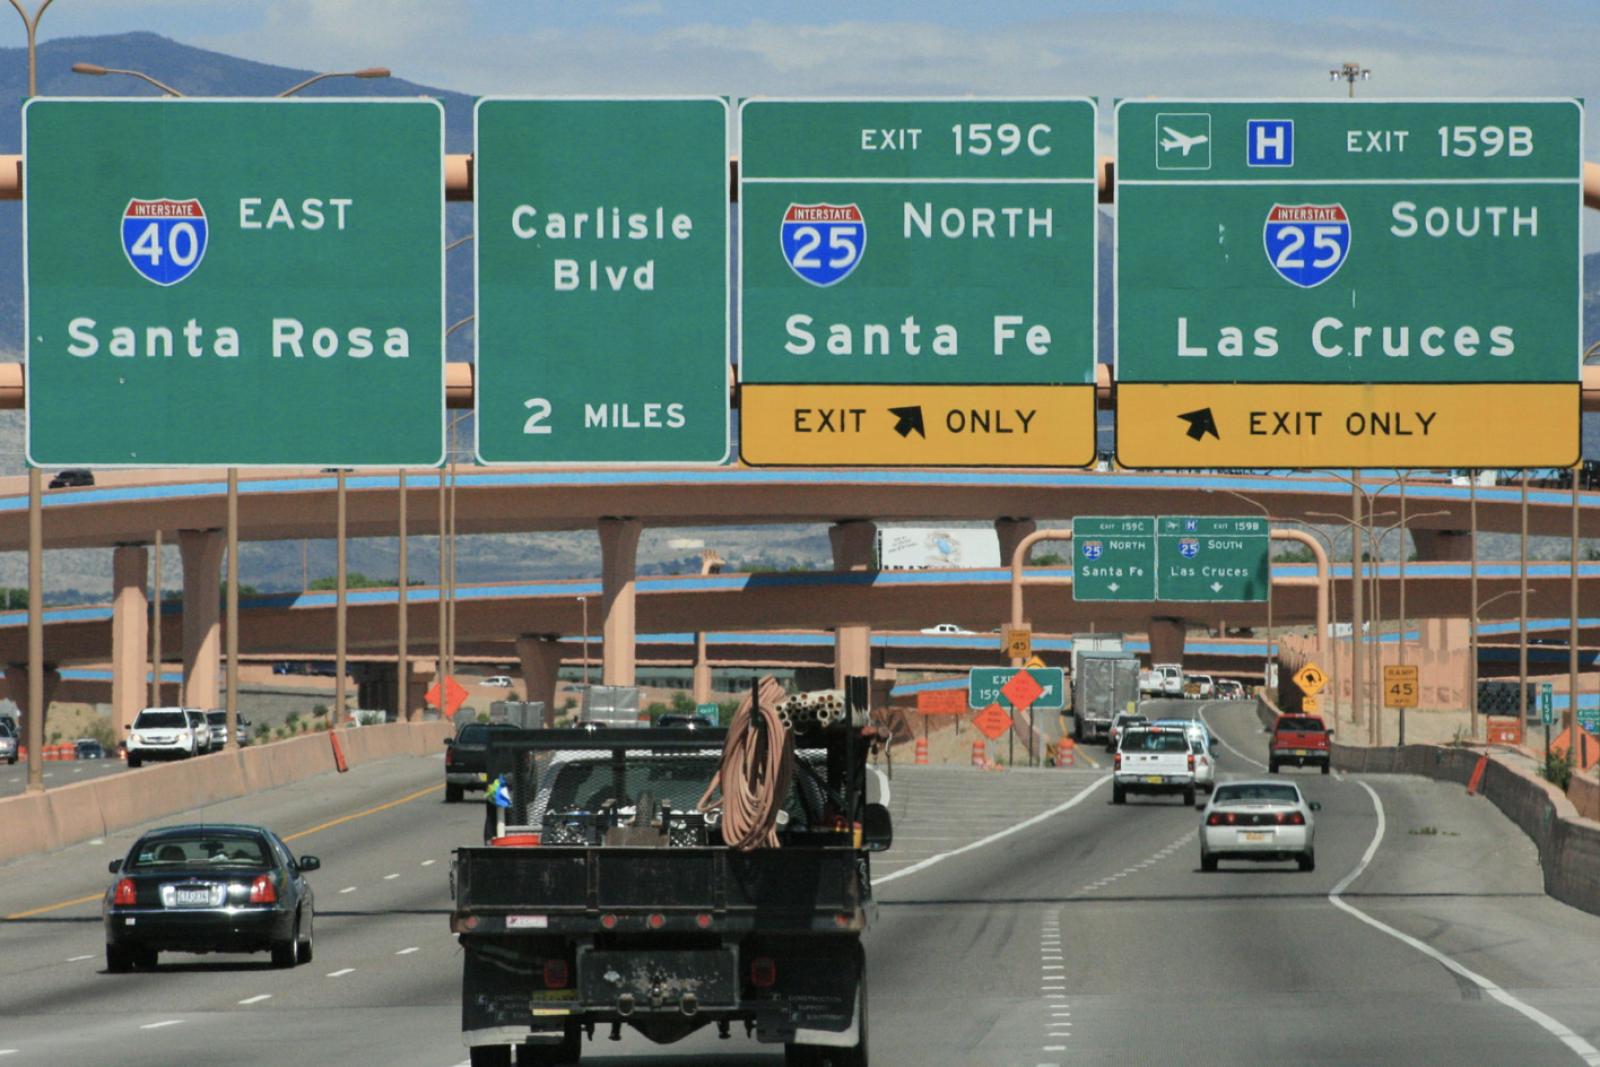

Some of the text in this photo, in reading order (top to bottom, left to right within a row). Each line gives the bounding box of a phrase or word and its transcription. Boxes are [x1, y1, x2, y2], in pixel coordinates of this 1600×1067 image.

[861, 123, 1051, 156] EXIT 159C
[1256, 126, 1284, 160] H
[1347, 125, 1534, 157] EXIT 159B
[135, 204, 193, 216] INTERSTATE
[239, 197, 353, 230] EAST
[511, 204, 693, 240] Carlisle
[794, 208, 852, 220] INTERSTATE
[903, 202, 1053, 238] NORTH
[1278, 208, 1337, 220] INTERSTATE
[1390, 201, 1538, 238] SOUTH
[131, 222, 199, 267] 40
[793, 226, 857, 269] 25
[1276, 226, 1342, 269] 25
[554, 259, 654, 291] Blvd
[67, 317, 409, 358] Santa Rosa
[784, 313, 1052, 356] Santa Fe
[1177, 316, 1515, 358] Las Cruces
[523, 397, 686, 434] 2 MILES
[794, 409, 1036, 434] EXIT ONLY
[1249, 411, 1437, 436] EXIT ONLY
[1121, 522, 1144, 531] 159C
[1235, 521, 1260, 531] 159B
[1086, 546, 1101, 557] 25
[1109, 540, 1146, 550] NORTH
[1182, 544, 1197, 555] 25
[1207, 539, 1243, 550] SOUTH
[1082, 565, 1144, 577] Santa Fe
[1171, 566, 1249, 577] Las Cruces
[992, 675, 1013, 685] EXI
[1390, 683, 1413, 696] 45
